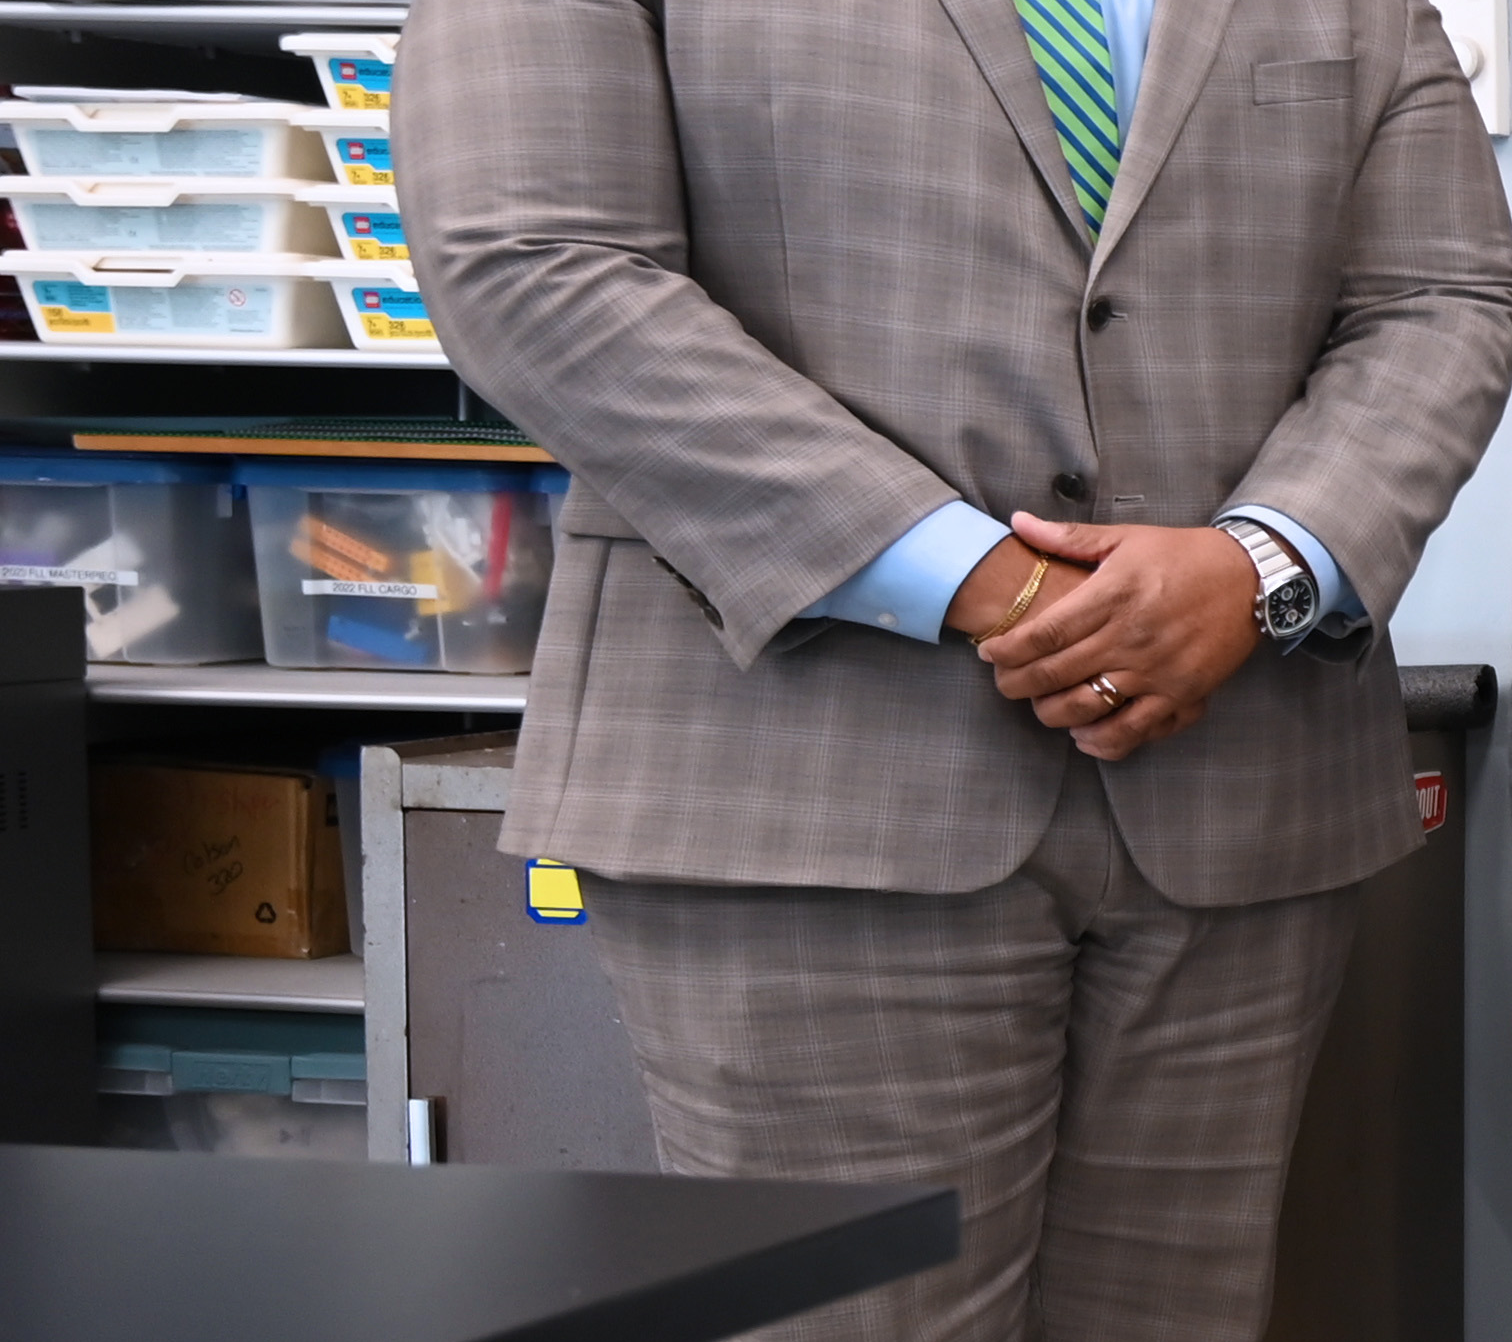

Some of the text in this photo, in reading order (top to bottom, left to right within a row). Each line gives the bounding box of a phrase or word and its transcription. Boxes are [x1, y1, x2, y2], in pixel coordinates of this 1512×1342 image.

[332, 582, 418, 596] 2022 FLL CARGO
